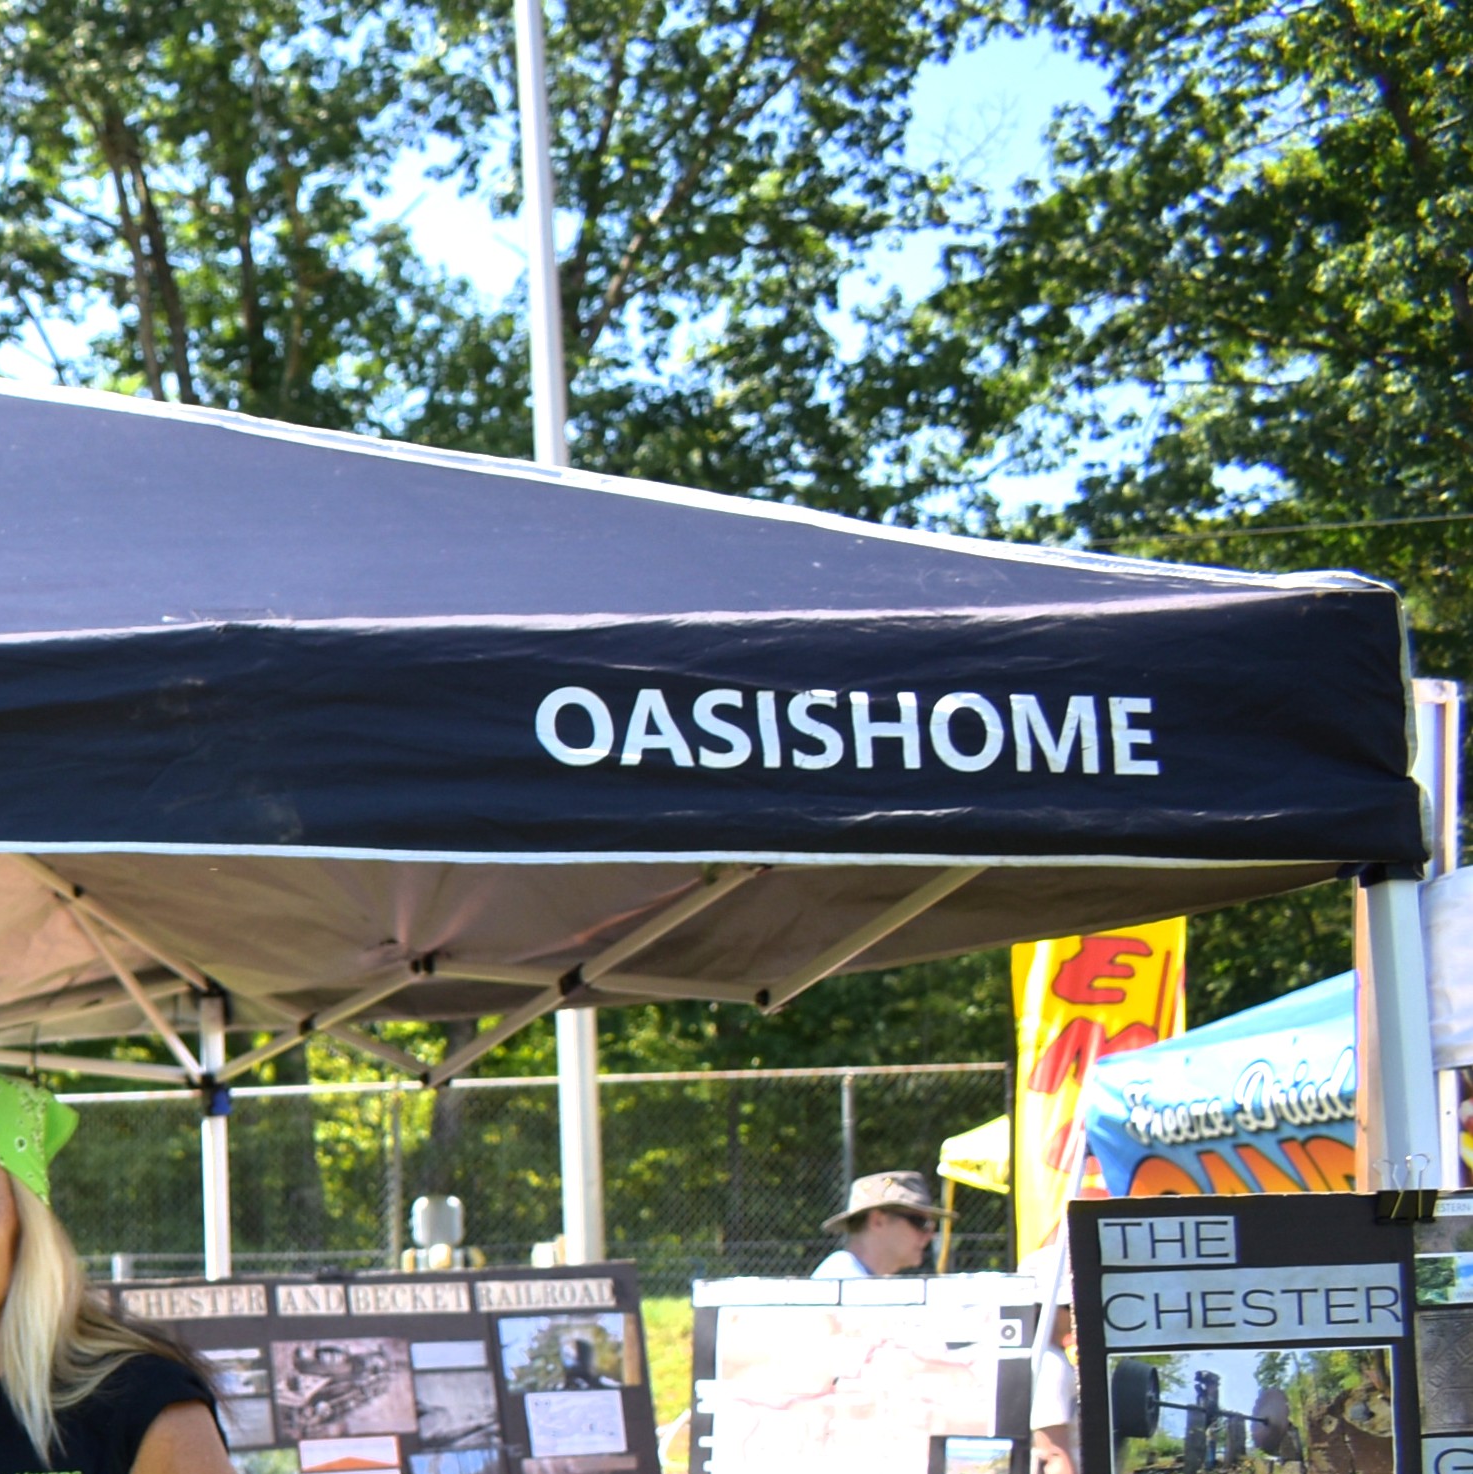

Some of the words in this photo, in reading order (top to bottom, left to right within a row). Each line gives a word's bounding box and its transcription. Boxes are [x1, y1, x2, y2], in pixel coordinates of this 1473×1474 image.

[534, 684, 1160, 776] OASISHOME
[1234, 1046, 1354, 1130] Dried
[1103, 1221, 1230, 1259] THE
[278, 1285, 346, 1315] AND
[351, 1282, 470, 1313] BECKET
[478, 1279, 616, 1310] RAILROAD
[1103, 1285, 1403, 1333] CHESTER
